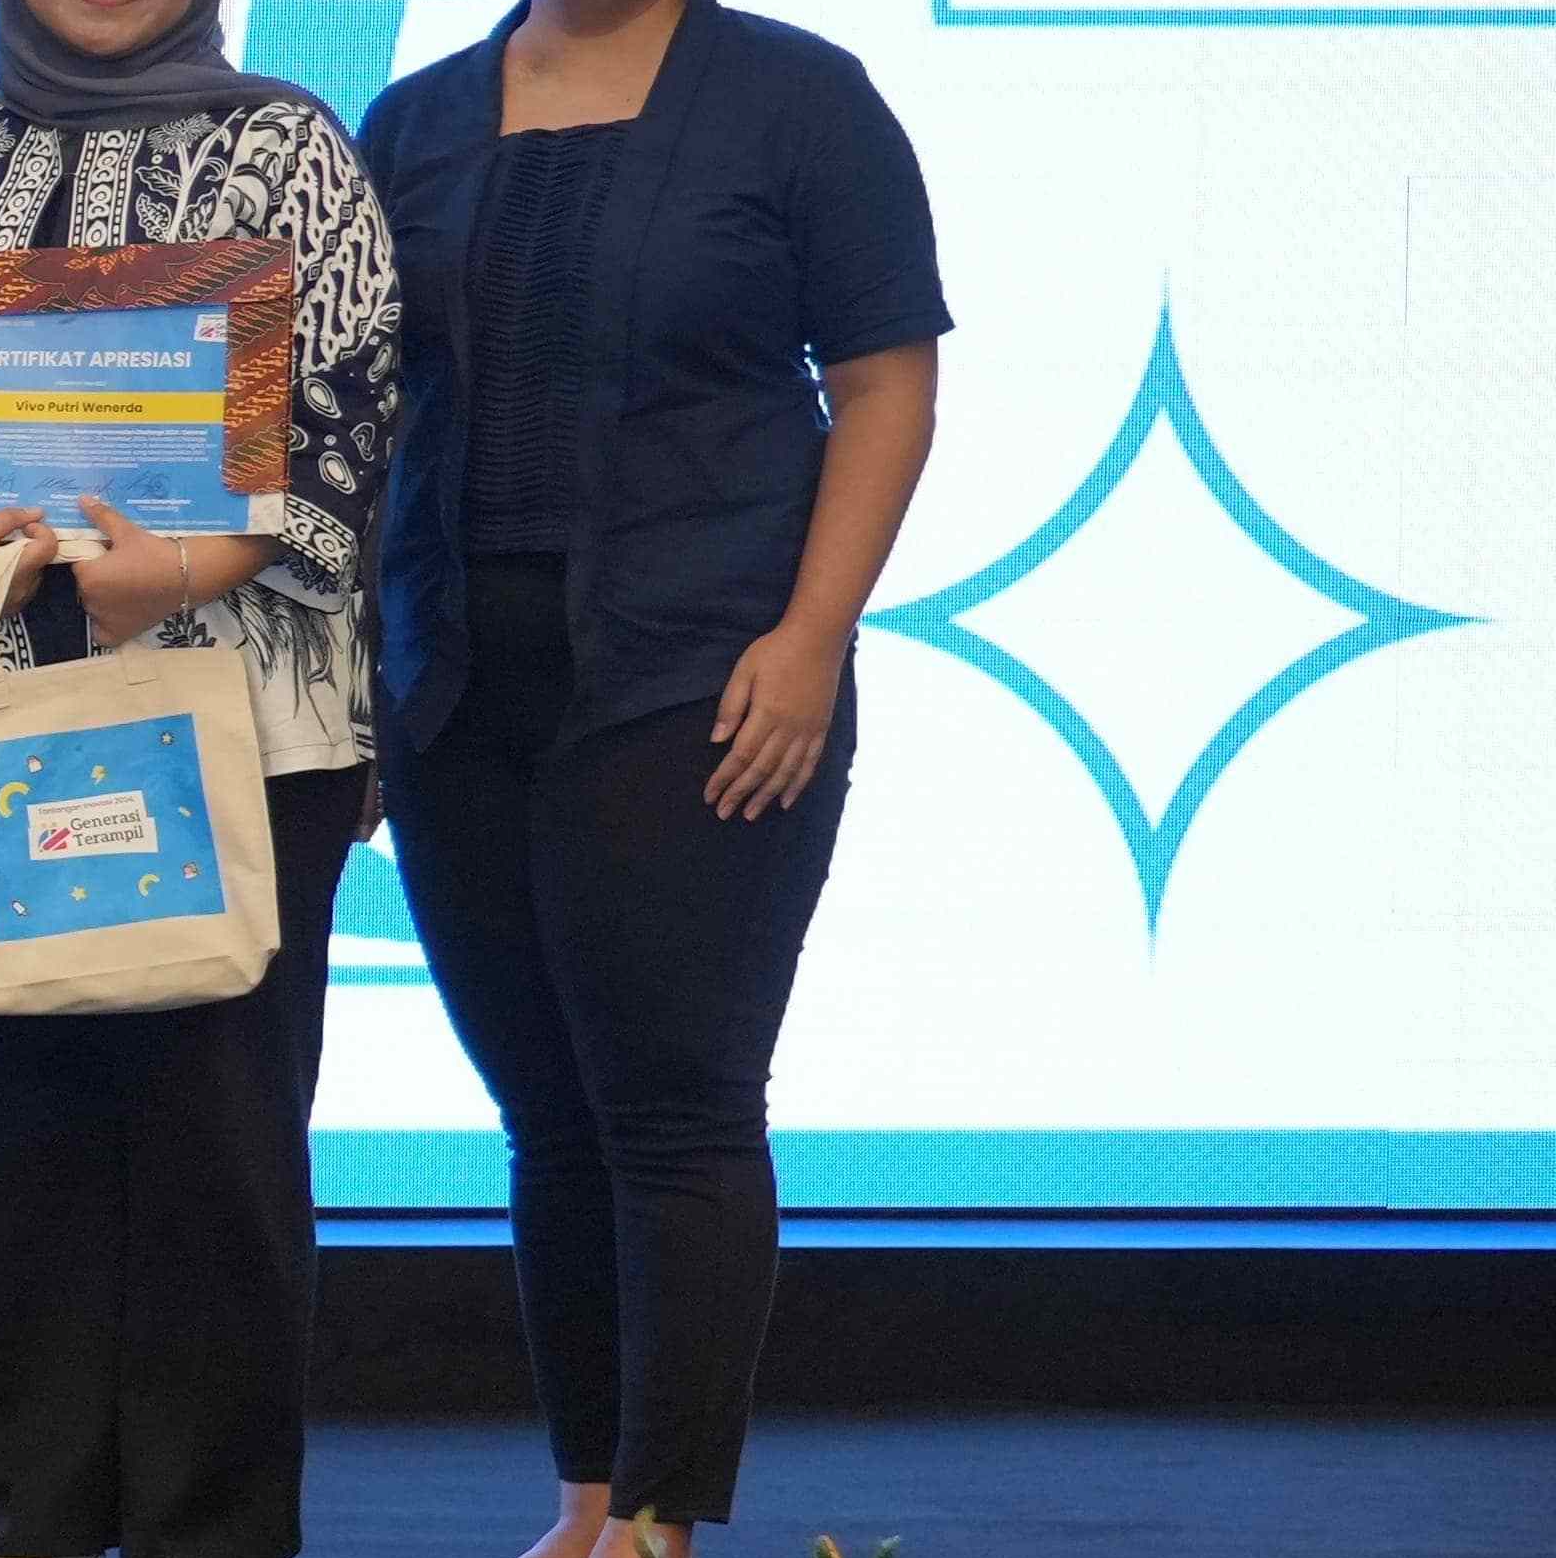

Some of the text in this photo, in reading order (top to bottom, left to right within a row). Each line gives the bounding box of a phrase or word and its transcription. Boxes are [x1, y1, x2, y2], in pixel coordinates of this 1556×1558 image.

[89, 350, 192, 368] APRESIASI
[48, 401, 79, 413] Putri
[70, 809, 141, 831] Generasi
[73, 825, 144, 847] Terampil
